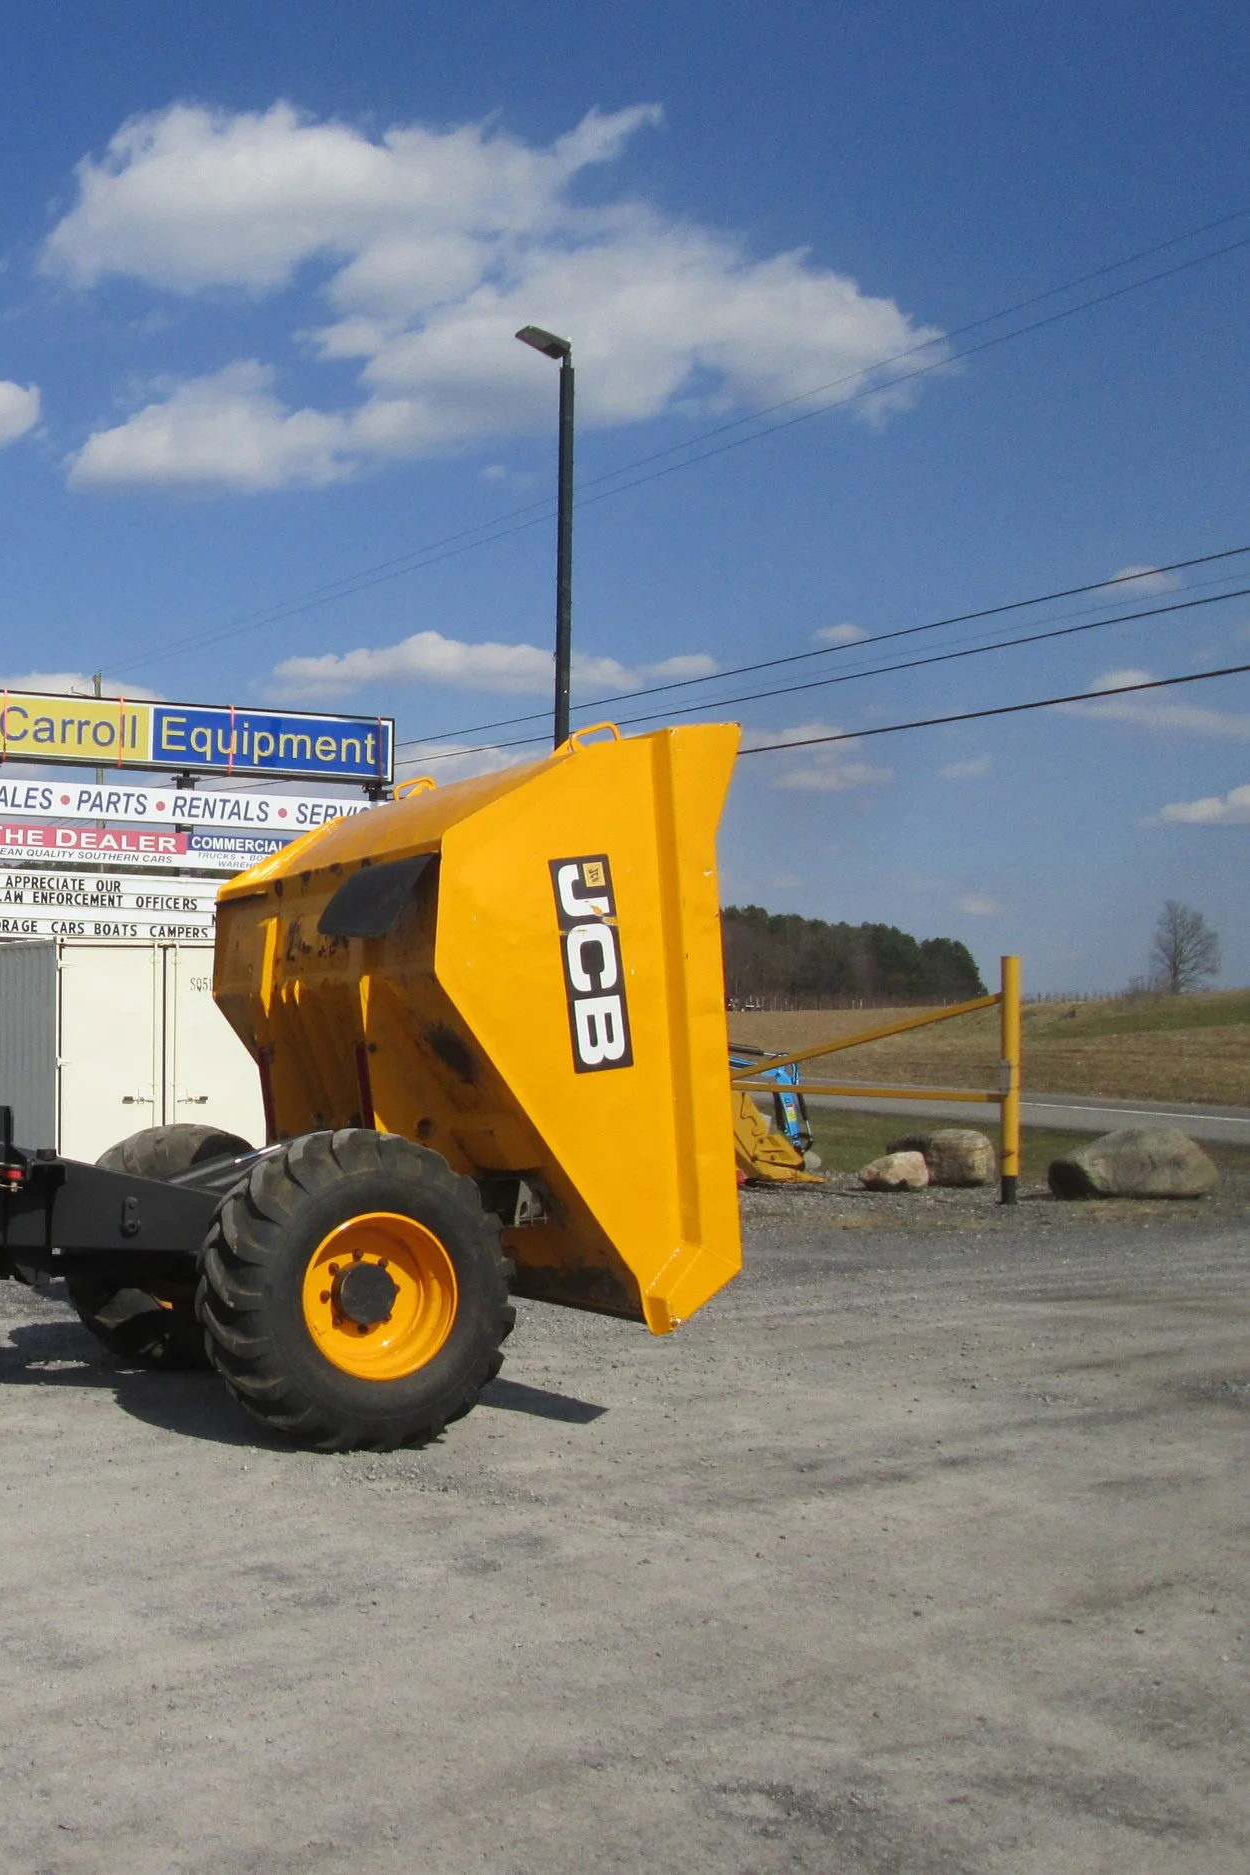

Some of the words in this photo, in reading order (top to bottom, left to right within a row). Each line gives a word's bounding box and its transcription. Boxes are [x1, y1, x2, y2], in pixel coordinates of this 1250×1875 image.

[0, 706, 137, 748] Carroll
[161, 716, 376, 765] Equipment
[77, 790, 148, 815] PARTS
[172, 796, 270, 822] RENTALS
[55, 829, 177, 853] DEALER
[27, 849, 74, 860] QUALITY
[77, 851, 141, 862] SOUTHERN
[142, 855, 172, 864] CARS
[197, 852, 236, 860] TRUCKS
[6, 875, 85, 891] APPRECIATE
[96, 880, 121, 893] OUR
[33, 891, 123, 907] ENFORCEMENT
[136, 896, 197, 910] OFFICERS
[51, 921, 85, 934] CARS
[94, 923, 137, 936] BOATS
[149, 925, 208, 938] CAMPERS
[558, 863, 625, 1065] JCB
